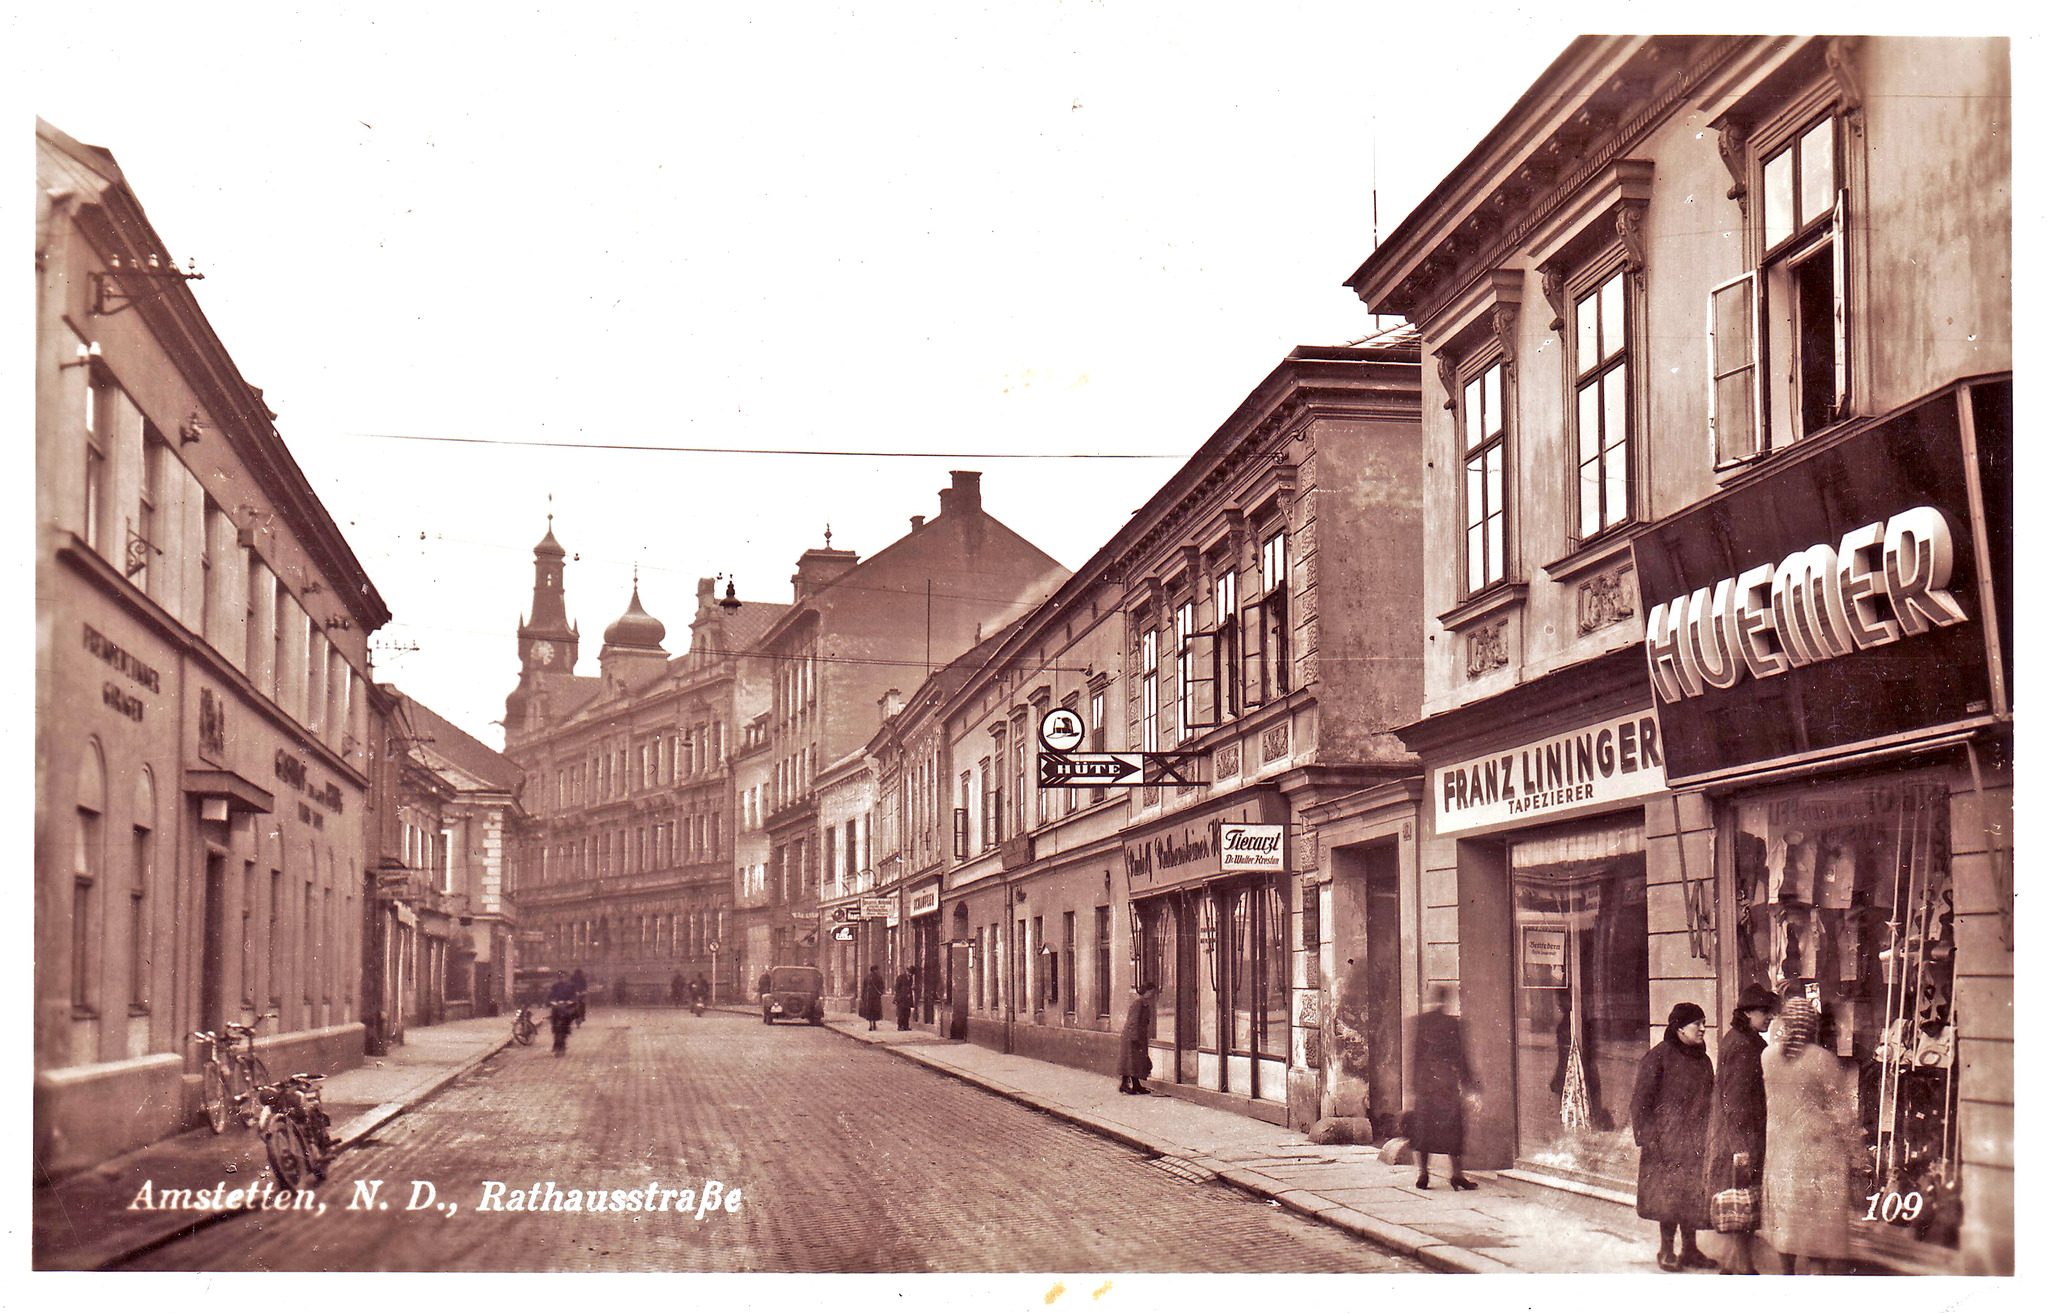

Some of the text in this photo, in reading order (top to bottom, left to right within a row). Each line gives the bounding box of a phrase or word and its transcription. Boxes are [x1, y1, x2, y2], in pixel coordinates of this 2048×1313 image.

[1647, 506, 1968, 704] HUEMER
[1057, 761, 1121, 775] HÜTE
[1444, 716, 1663, 813] FRANZ LININGER
[1508, 783, 1594, 815] TAPEZIERER
[1224, 829, 1281, 854] Tierarzt
[1234, 854, 1255, 865] Walter
